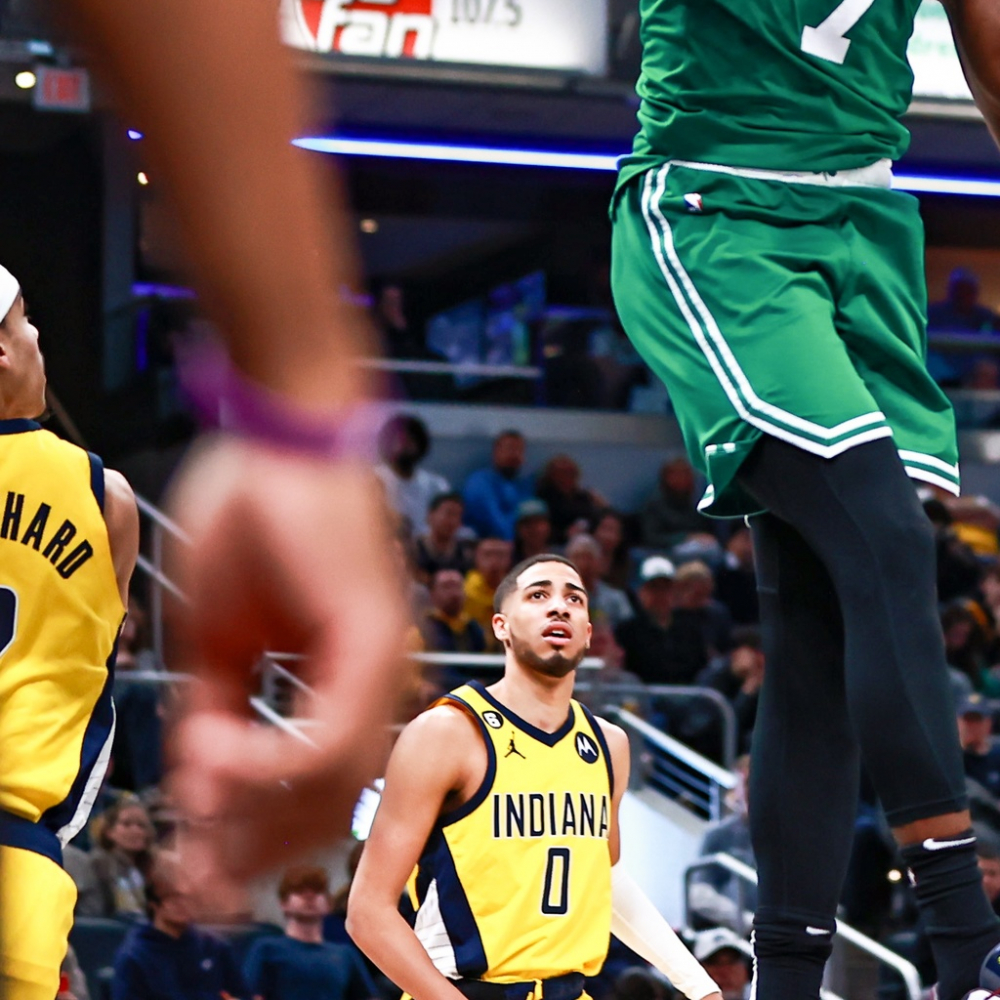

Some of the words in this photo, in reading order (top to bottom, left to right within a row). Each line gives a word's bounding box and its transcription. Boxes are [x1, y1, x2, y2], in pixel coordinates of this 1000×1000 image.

[0, 491, 93, 580] HARD
[483, 711, 501, 729] 6
[493, 793, 608, 838] INDIANA
[541, 847, 571, 915] 0
